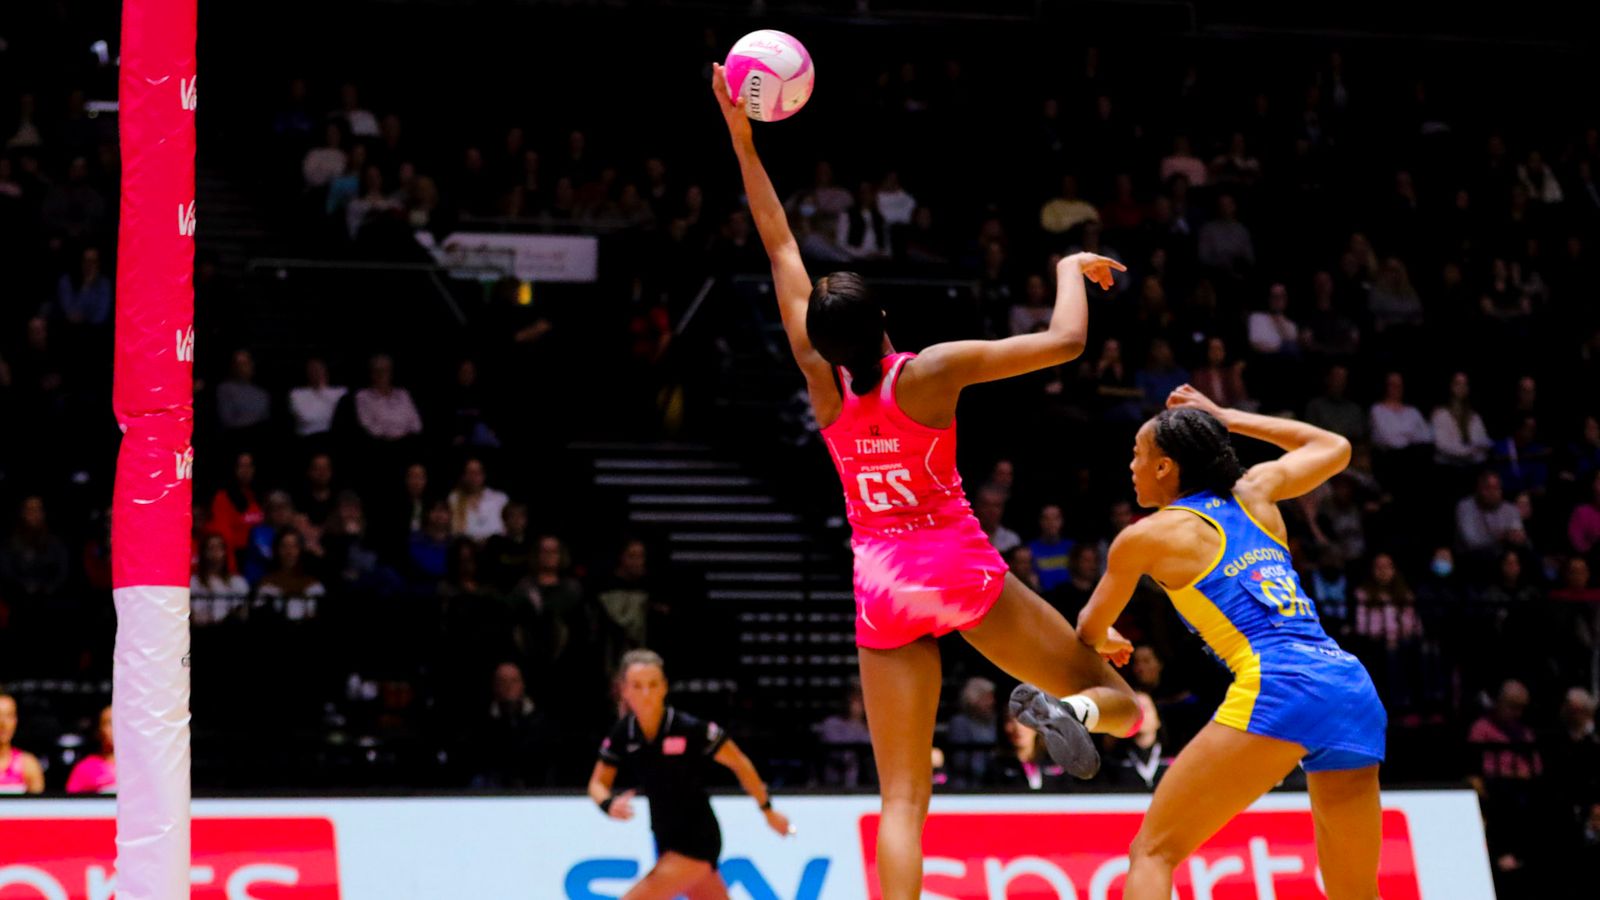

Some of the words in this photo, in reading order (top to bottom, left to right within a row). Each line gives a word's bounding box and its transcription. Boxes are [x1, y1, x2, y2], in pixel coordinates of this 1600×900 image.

[855, 438, 900, 454] TCHINE
[856, 469, 919, 511] GS
[1223, 548, 1285, 577] GUSCOTH
